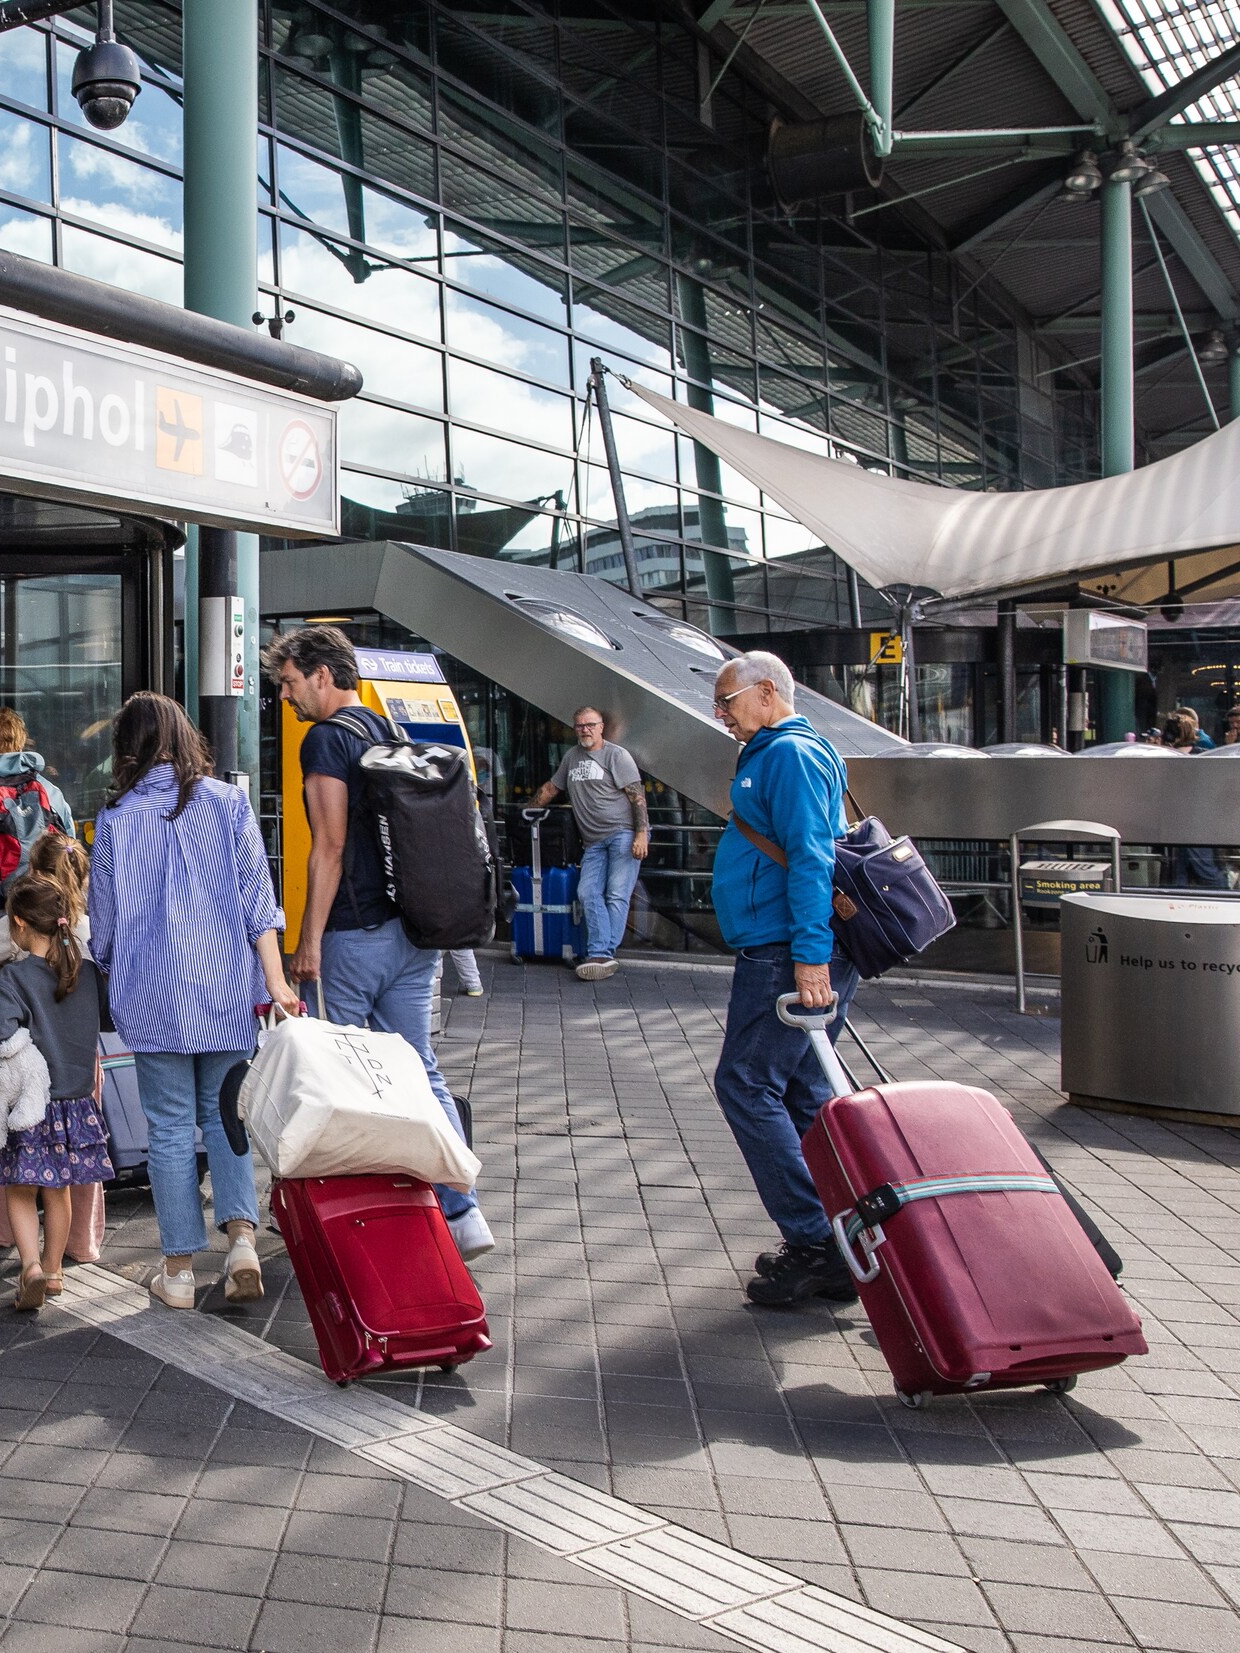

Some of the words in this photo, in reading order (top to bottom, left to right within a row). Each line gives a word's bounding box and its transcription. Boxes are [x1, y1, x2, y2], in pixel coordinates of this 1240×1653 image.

[880, 635, 896, 659] E
[379, 657, 405, 673] Train
[405, 659, 436, 676] tickets
[378, 814, 395, 877] HANSEN
[1036, 880, 1077, 891] Smoking
[1120, 955, 1153, 970] Help
[1158, 959, 1175, 969] us
[1181, 960, 1197, 970] to
